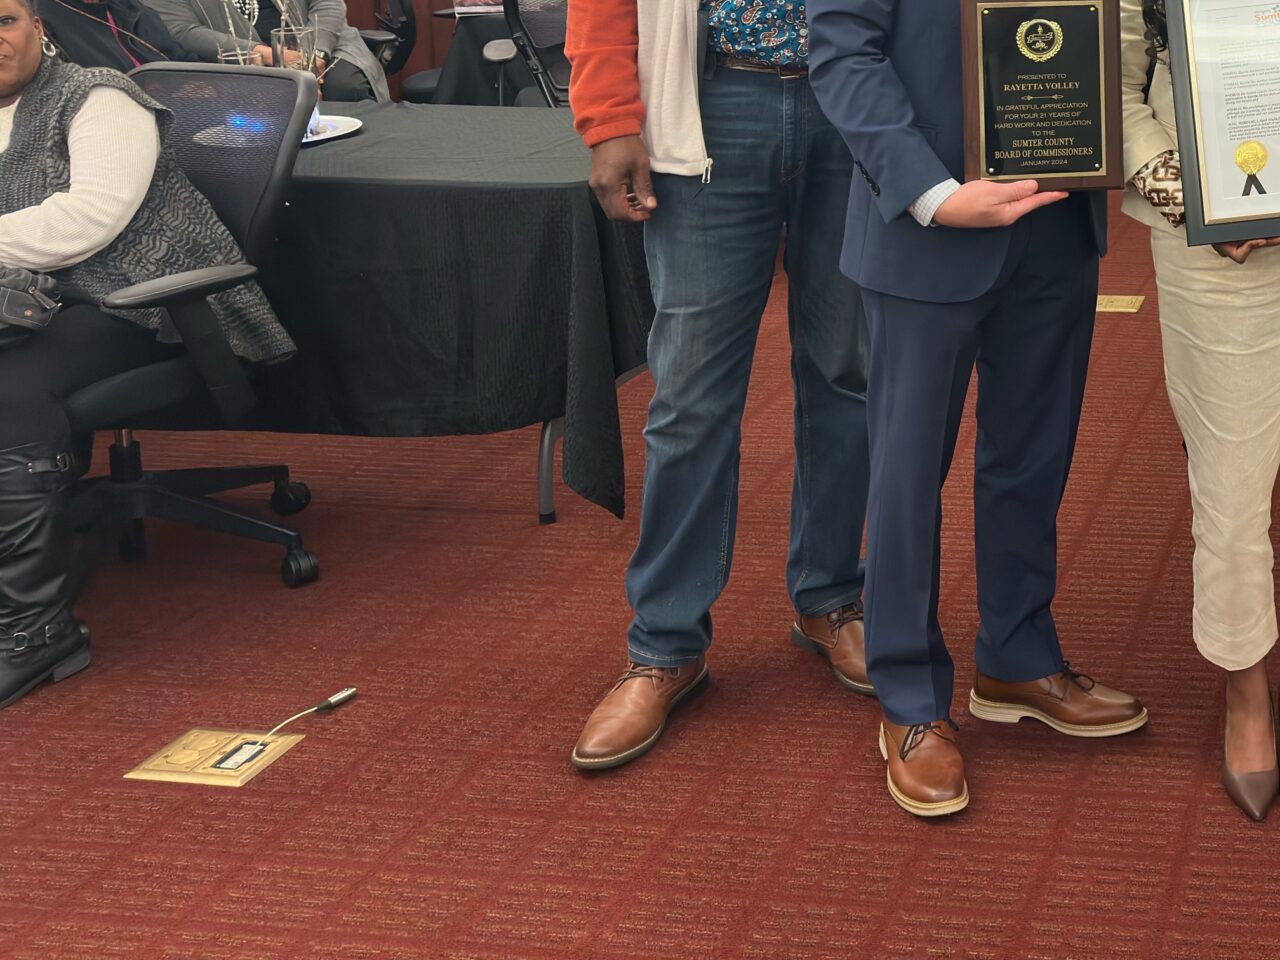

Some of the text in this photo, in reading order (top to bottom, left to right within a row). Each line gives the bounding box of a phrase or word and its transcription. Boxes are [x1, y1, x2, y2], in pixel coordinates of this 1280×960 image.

[1003, 81, 1080, 91] RAYETTA VOLLEY
[1051, 119, 1092, 127] DEDICATION
[1012, 137, 1074, 148] SUMTER COUNTY
[994, 147, 1093, 159] BOARD OF COMMISSIONERS
